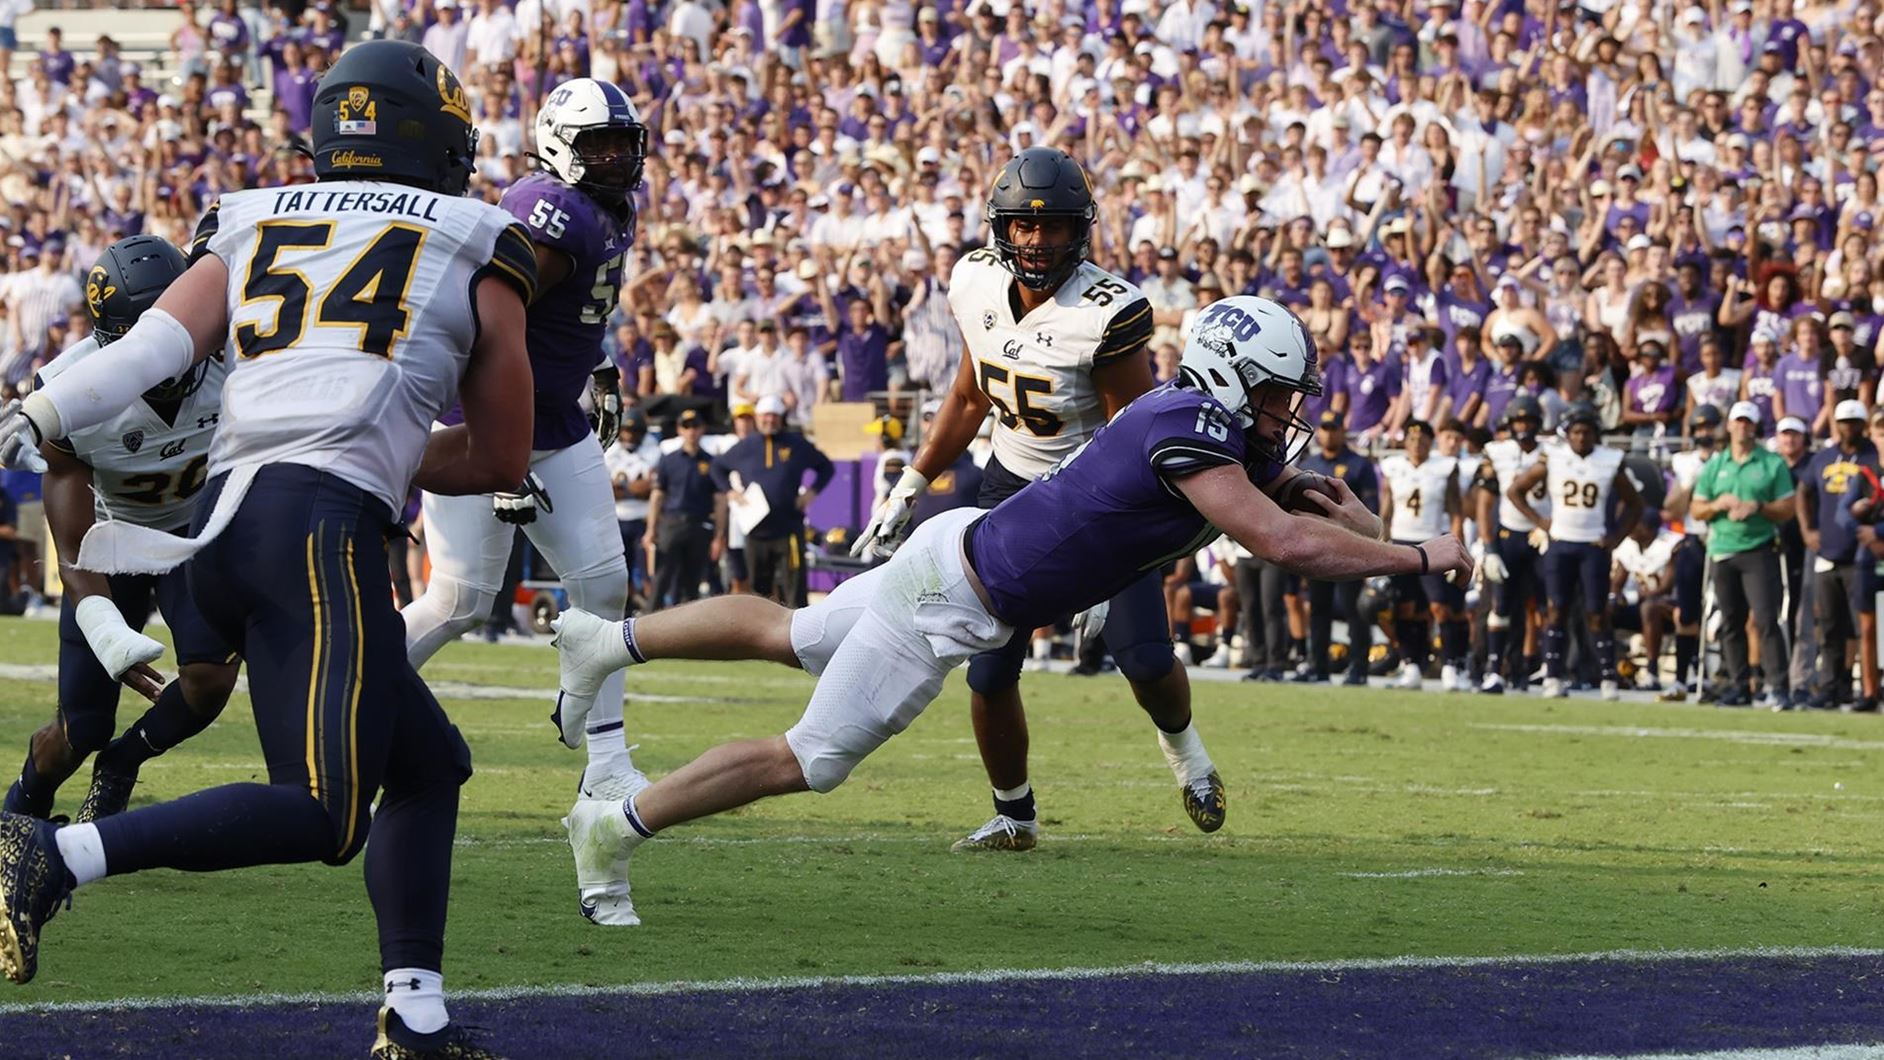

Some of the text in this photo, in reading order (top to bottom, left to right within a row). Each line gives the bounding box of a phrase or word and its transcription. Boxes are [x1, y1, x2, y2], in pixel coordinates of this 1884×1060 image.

[331, 150, 383, 169] California
[273, 191, 439, 222] TATTERSALL
[528, 199, 571, 239] 55
[233, 219, 429, 360] 54
[1081, 278, 1128, 307] 55
[1203, 304, 1262, 342] TCU
[1002, 339, 1023, 360] Cal
[979, 358, 1066, 437] 55
[1194, 401, 1232, 443] 15
[160, 438, 185, 461] Cal
[1406, 488, 1421, 517] 4
[1563, 479, 1599, 509] 29
